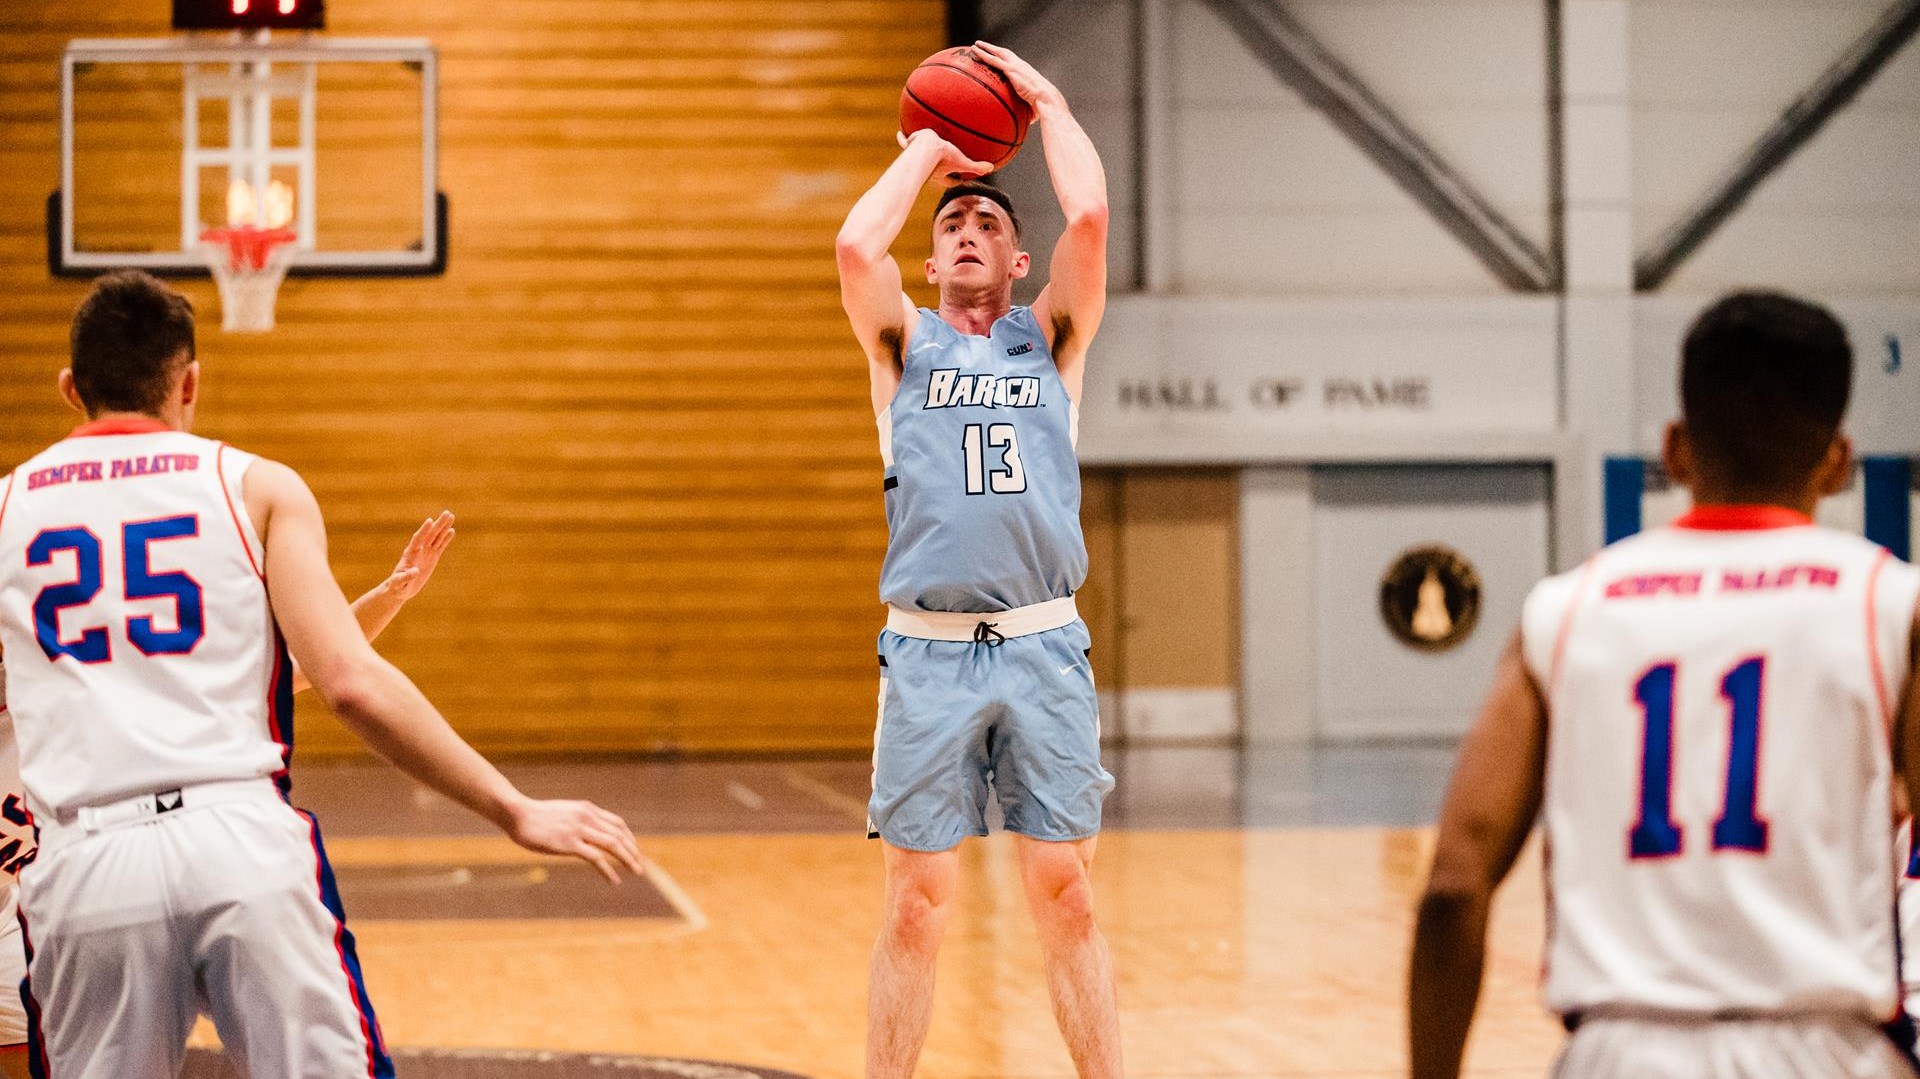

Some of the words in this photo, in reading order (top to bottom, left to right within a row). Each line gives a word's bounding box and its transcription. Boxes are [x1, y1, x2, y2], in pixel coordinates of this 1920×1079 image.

[28, 462, 103, 491] SEMPER
[110, 454, 200, 479] PARATUS
[961, 423, 1028, 496] 13
[26, 514, 206, 664] 25
[1628, 656, 1769, 859] 11
